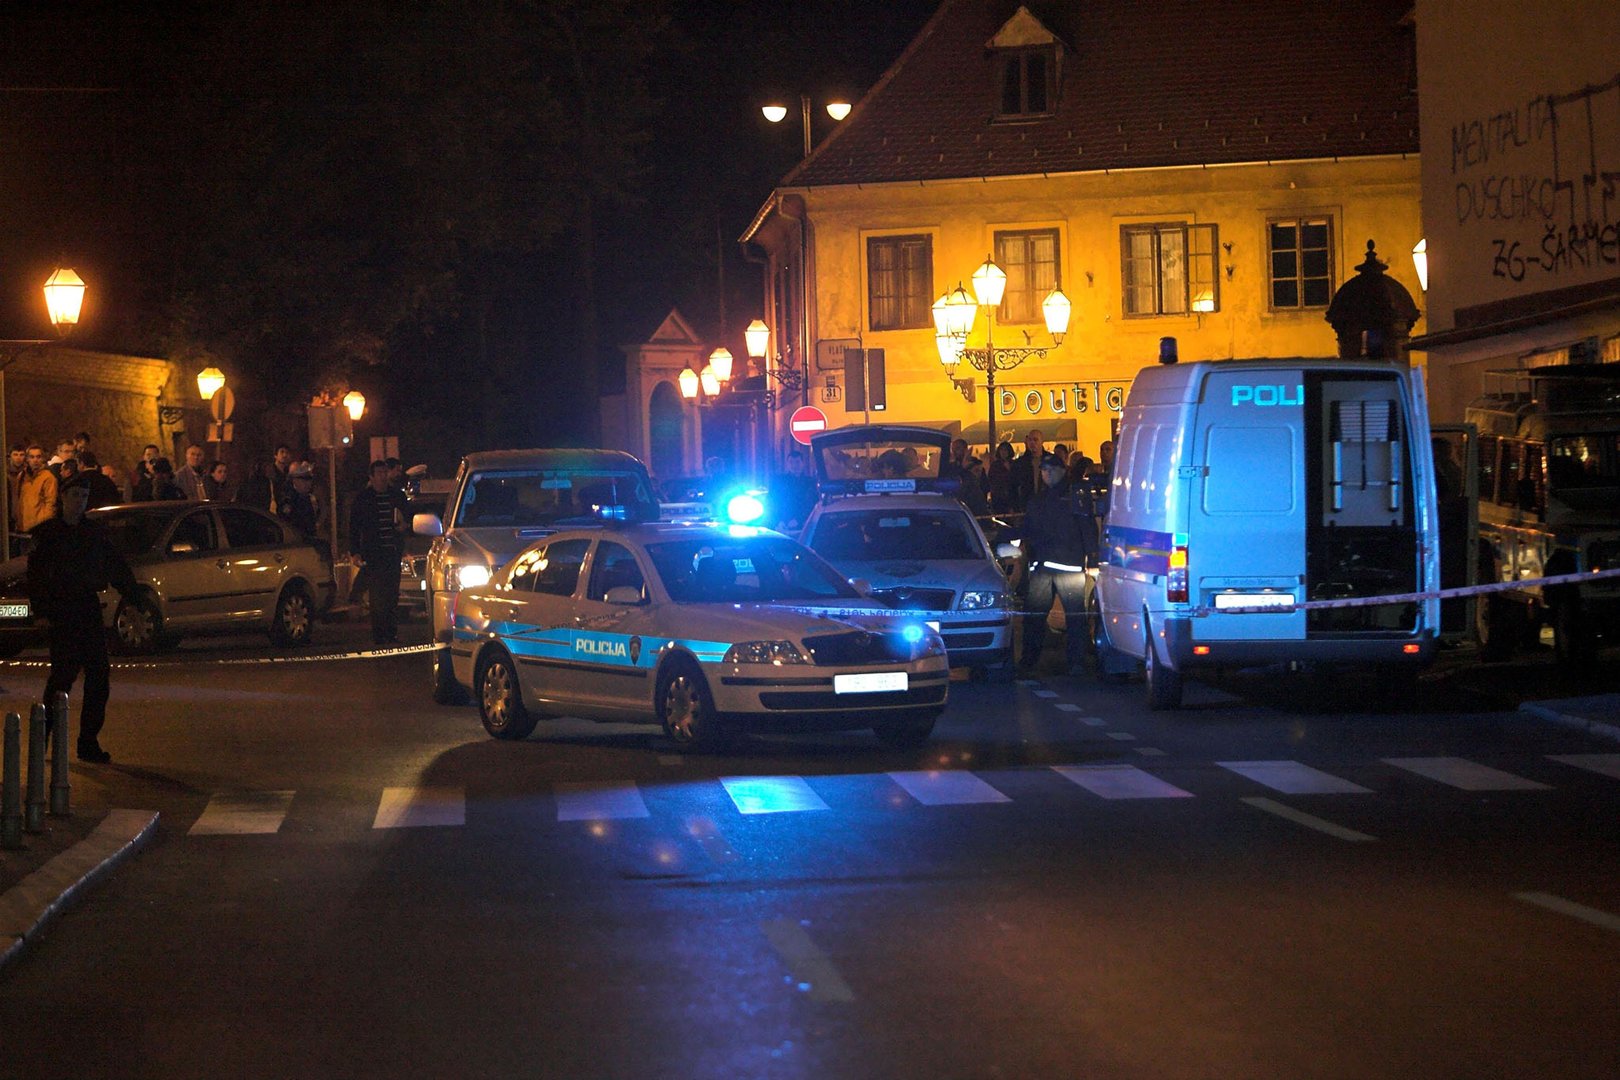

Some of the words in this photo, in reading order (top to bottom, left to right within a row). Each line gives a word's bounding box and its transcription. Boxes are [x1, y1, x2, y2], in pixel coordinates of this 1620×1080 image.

[1492, 222, 1620, 282] ZG-ŠARME
[826, 388, 836, 397] 31
[1232, 385, 1304, 406] POLI
[866, 481, 913, 489] POLICIJA
[575, 638, 626, 657] POLICIJA
